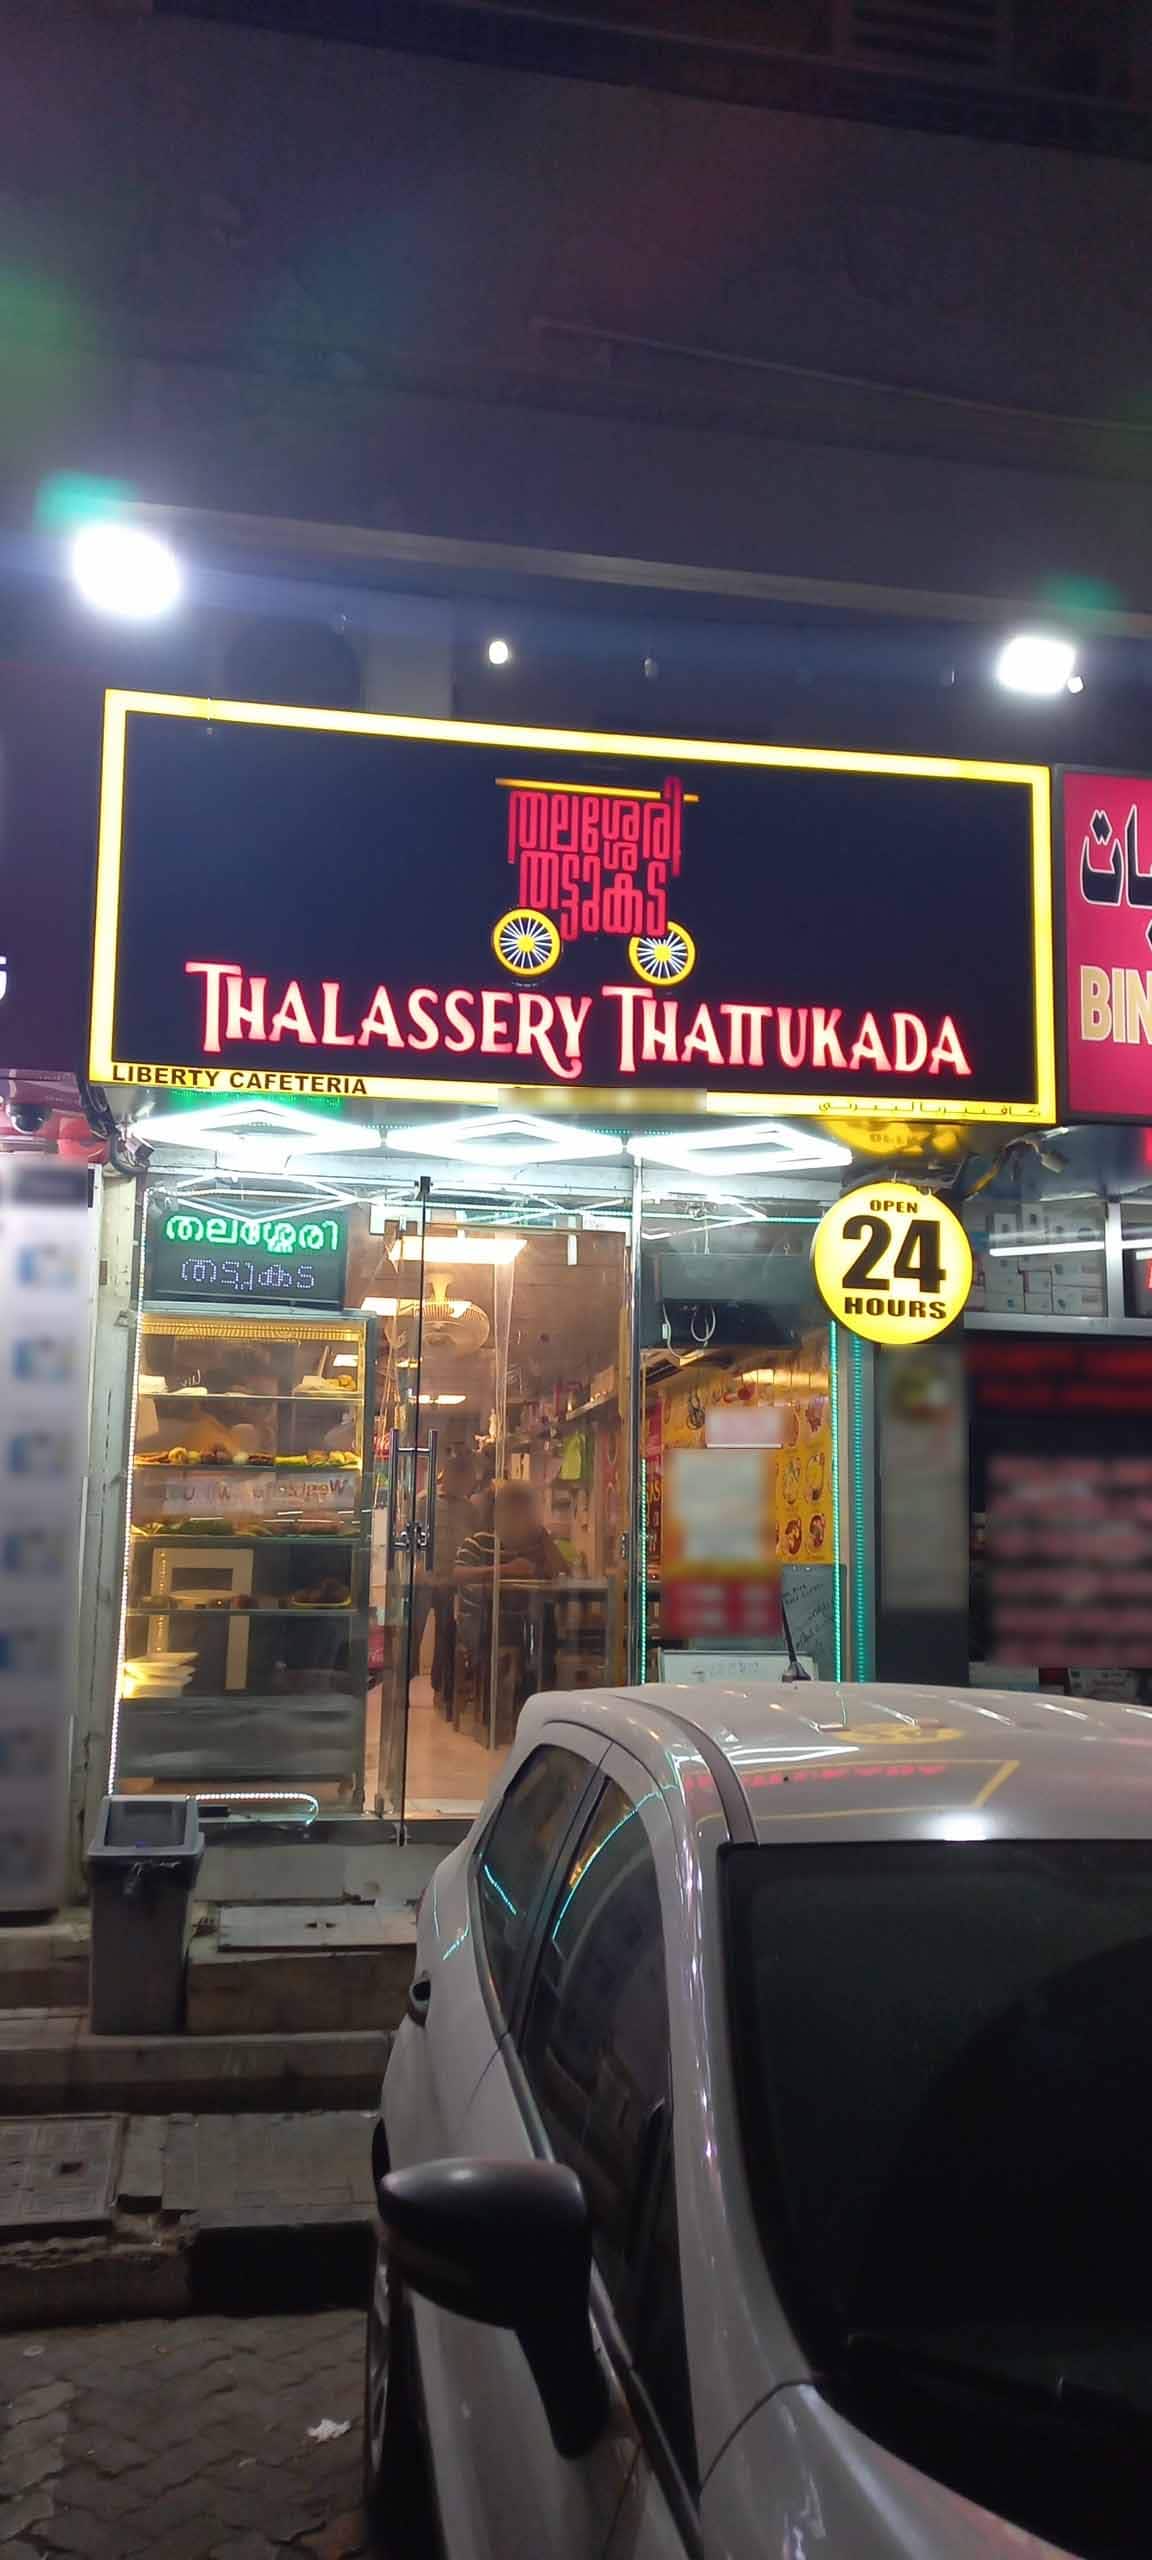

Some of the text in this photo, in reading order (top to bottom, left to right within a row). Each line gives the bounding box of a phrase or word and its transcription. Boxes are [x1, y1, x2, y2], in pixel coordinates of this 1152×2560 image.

[185, 961, 972, 1079] THALASSERY THATTUKADA
[112, 1064, 368, 1095] LIBERTY CAFETERIA
[869, 1199, 918, 1214] OPEN
[842, 1214, 946, 1294] 24
[844, 1297, 947, 1320] HOURS
